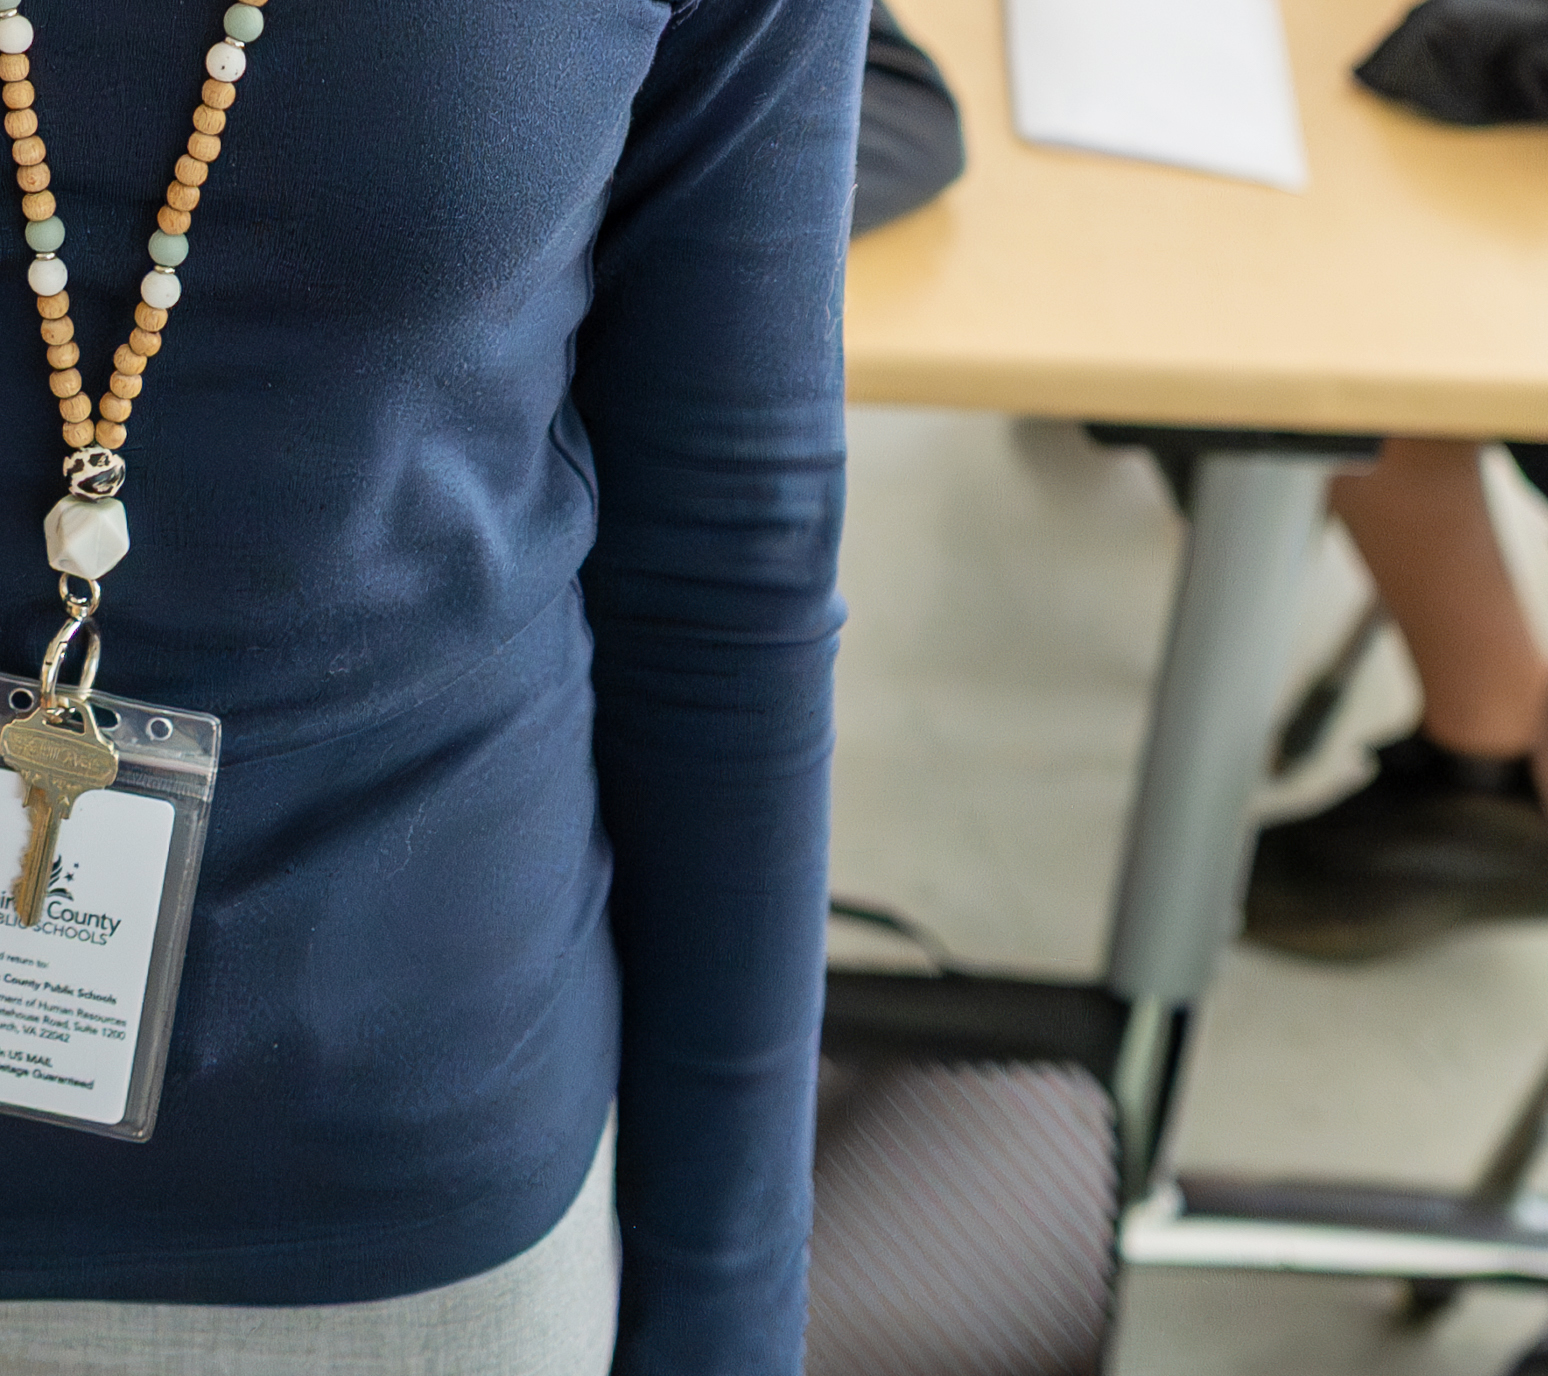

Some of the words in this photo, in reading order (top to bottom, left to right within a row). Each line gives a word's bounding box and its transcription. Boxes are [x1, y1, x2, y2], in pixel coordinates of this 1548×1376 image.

[47, 901, 121, 937] County
[33, 921, 108, 946] SCHOOLS
[7, 954, 34, 967] return
[4, 973, 41, 991] County
[43, 981, 74, 996] Public
[77, 988, 117, 1005] Schools
[25, 998, 38, 1008] of
[38, 1001, 74, 1017] Human
[76, 1008, 127, 1027] Resources
[21, 1025, 37, 1037] VA
[73, 1021, 99, 1036] Suite
[101, 1027, 127, 1041] 1200
[8, 1050, 23, 1062] US
[25, 1053, 53, 1068] MAIL
[32, 1068, 95, 1090] Guaranteed
